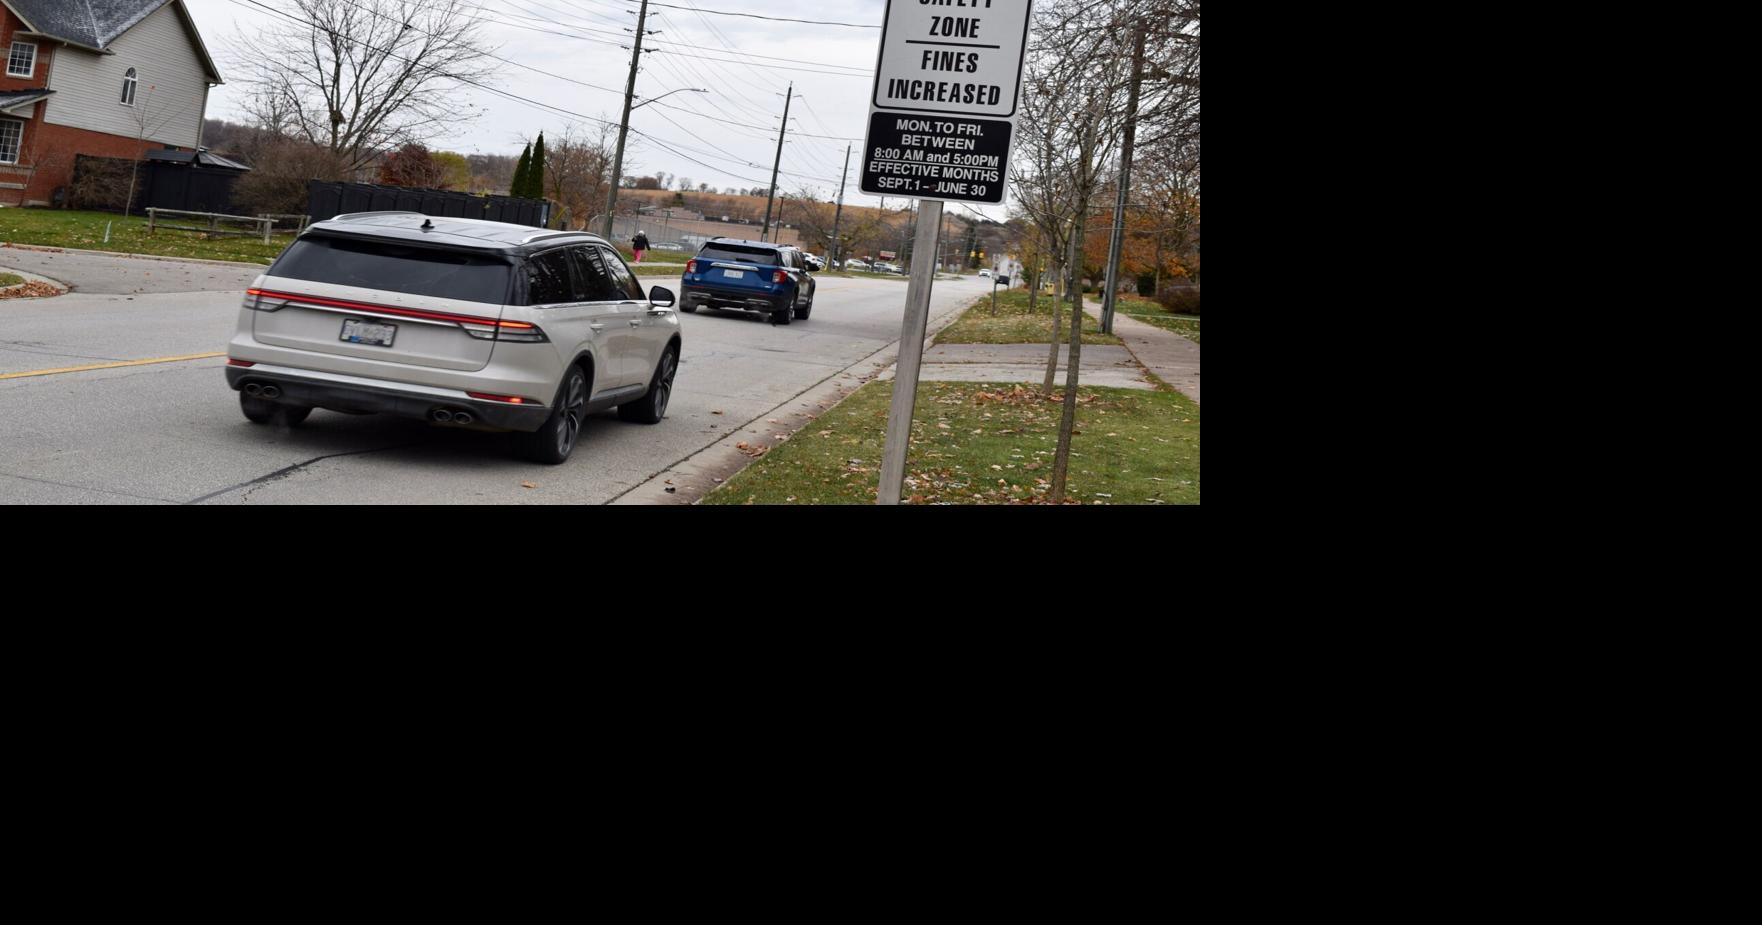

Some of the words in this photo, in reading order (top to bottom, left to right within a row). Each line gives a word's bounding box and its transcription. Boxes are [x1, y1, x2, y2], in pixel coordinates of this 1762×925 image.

[929, 16, 980, 38] ZONE
[921, 50, 979, 73] FINES
[888, 79, 1001, 105] INCREASED
[896, 118, 932, 133] MON.
[934, 121, 954, 134] TO
[957, 123, 984, 136] FRI.
[901, 134, 975, 150] BETWEEN
[874, 147, 900, 160] 8:00
[903, 149, 924, 161] AM
[926, 152, 950, 163] and
[953, 153, 999, 167] 5:00PM
[869, 161, 940, 178] EFFECTIVE
[942, 167, 999, 182] MONTHS
[935, 181, 968, 195] JUNE
[970, 184, 986, 196] 30
